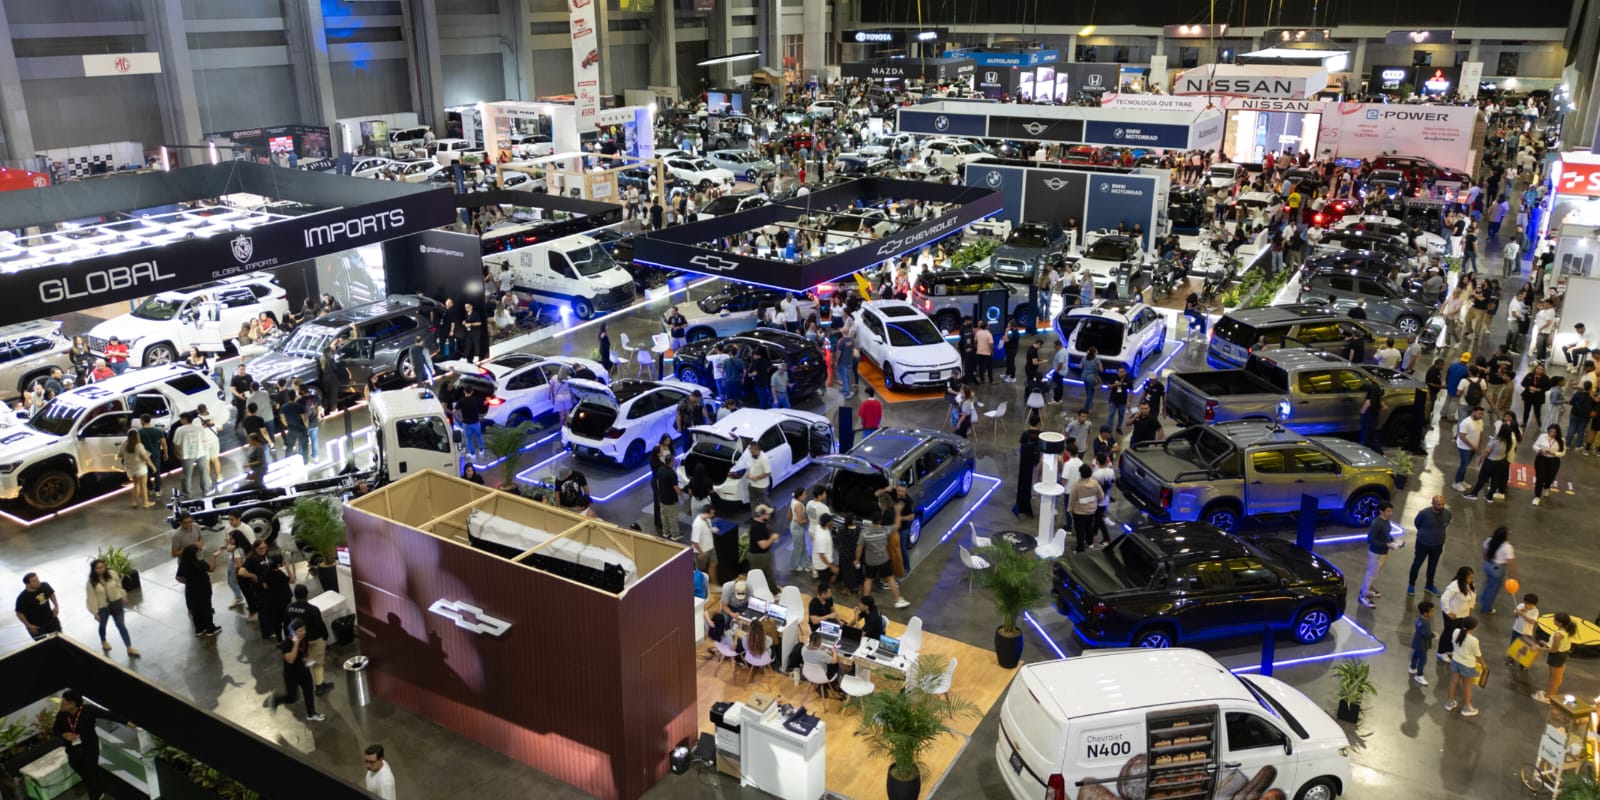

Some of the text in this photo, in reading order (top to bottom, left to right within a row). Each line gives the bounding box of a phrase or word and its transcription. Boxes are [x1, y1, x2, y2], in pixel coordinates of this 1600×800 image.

[871, 67, 904, 75] MAZDA
[1186, 79, 1292, 94] NISSAN
[1242, 100, 1309, 111] NISSAN
[1366, 109, 1449, 122] e-POWER
[304, 208, 405, 249] IMPORTS
[904, 215, 959, 245] CHEVROLET
[211, 257, 279, 278] GLOBAL IMPORTS
[38, 260, 176, 303] GLOBAL
[1087, 733, 1123, 743] Chevrolet
[1087, 740, 1132, 759] N400
